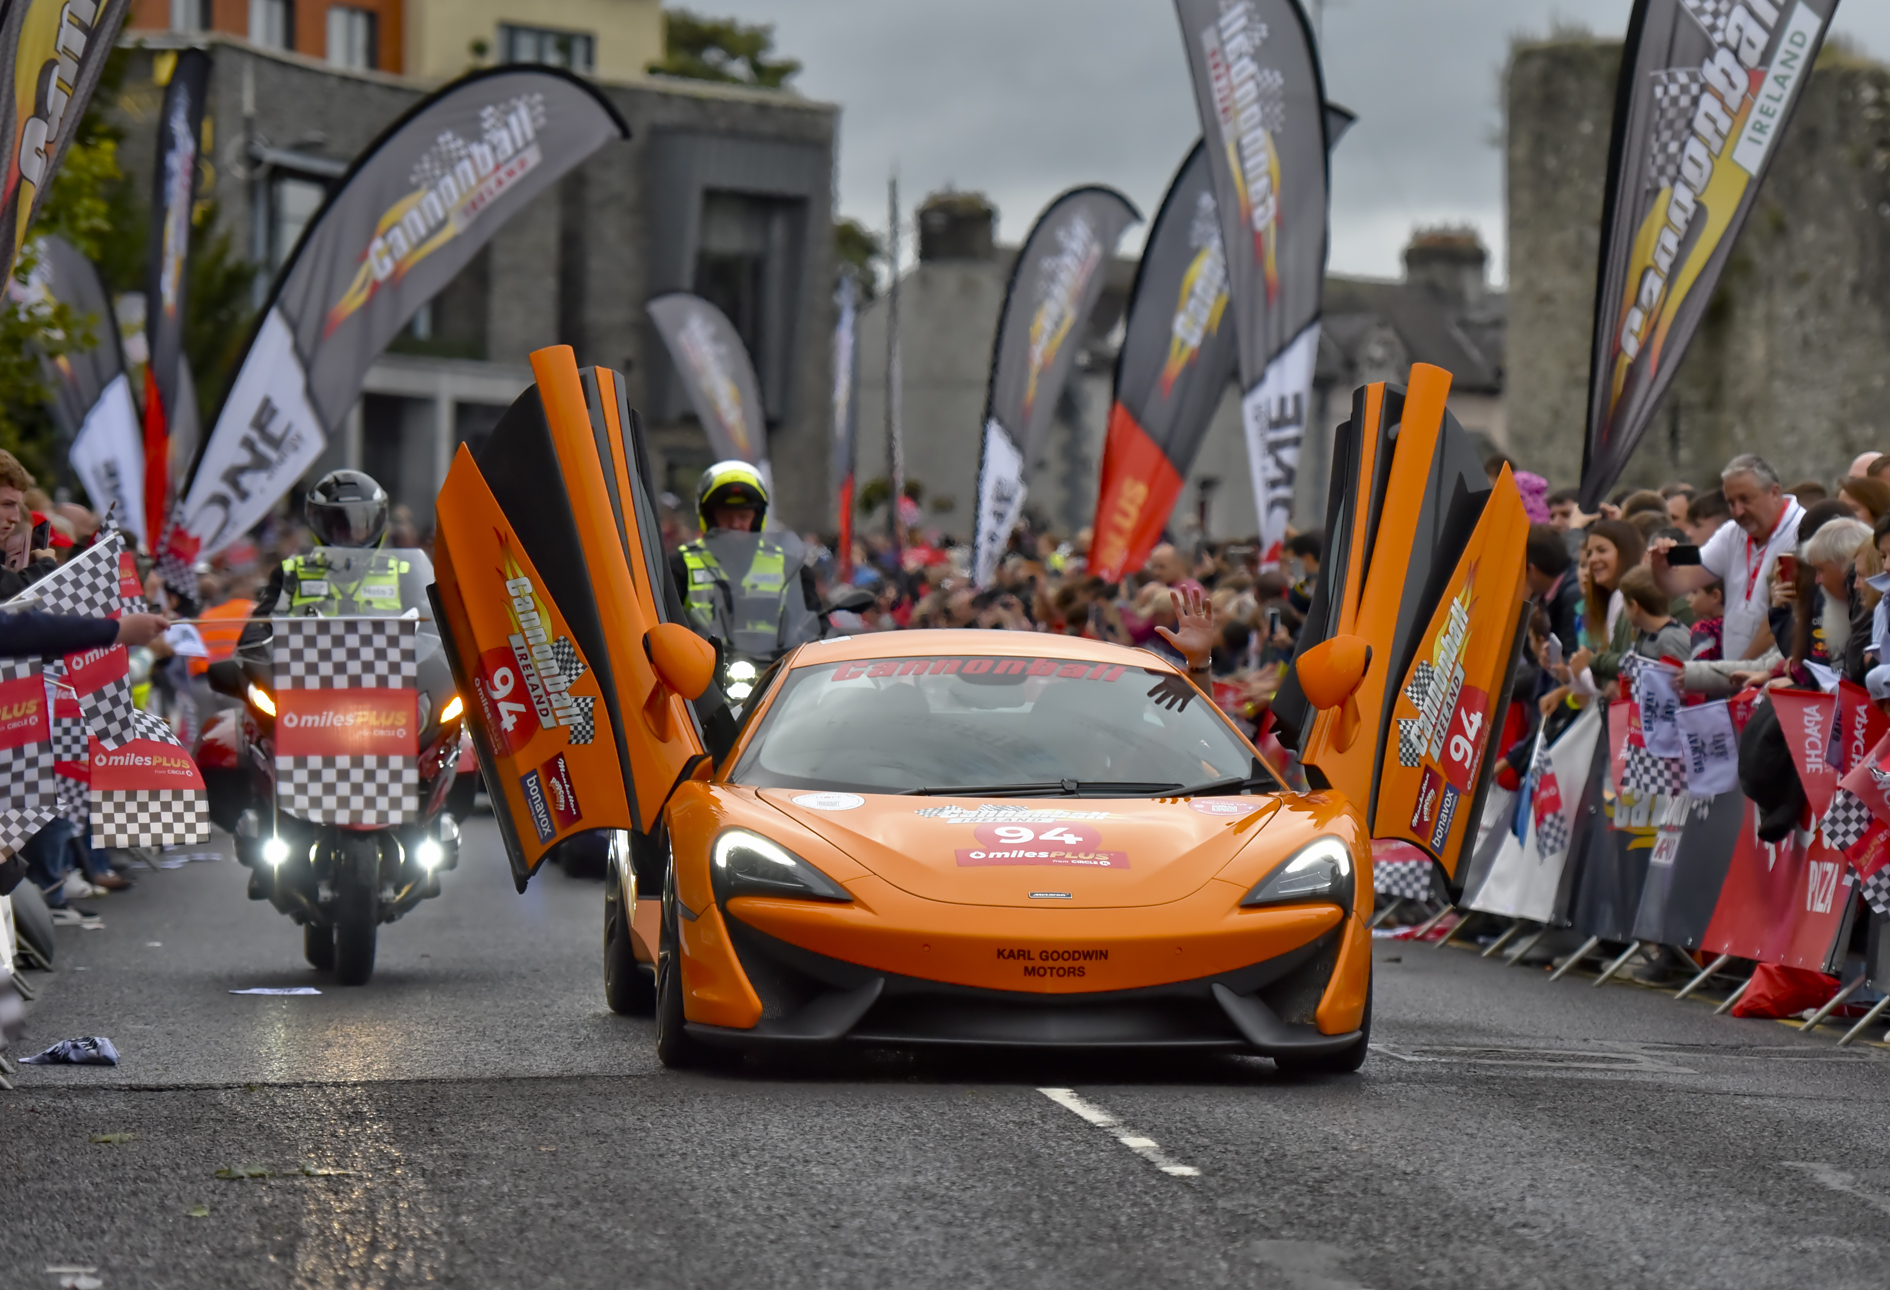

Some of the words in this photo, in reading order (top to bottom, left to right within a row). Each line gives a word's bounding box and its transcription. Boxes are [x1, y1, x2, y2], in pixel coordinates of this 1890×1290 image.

[1746, 29, 1808, 147] IRELAND
[368, 100, 536, 283] Cannonball
[506, 576, 585, 727] Cannonball
[831, 658, 1127, 682] Cannonball
[1410, 597, 1469, 757] Cannonball
[485, 666, 527, 733] 94
[514, 645, 550, 719] IRELAND
[300, 711, 407, 727] milesPLUS
[1434, 674, 1461, 750] IRELAND
[1450, 707, 1483, 770] 94
[108, 753, 190, 769] milesPLUS
[557, 757, 577, 816] Manhattan
[526, 774, 552, 837] bonavox
[550, 776, 565, 811] popcorn
[939, 809, 1110, 820] Cannonball
[1411, 772, 1430, 828] Manhattan
[1423, 788, 1436, 822] popcorn
[1431, 789, 1454, 848] bonavox
[988, 850, 1109, 861] milesPLUS
[994, 826, 1083, 844] 94
[997, 948, 1035, 960] KARL
[1039, 949, 1109, 962] GOODWIN
[1023, 966, 1086, 978] MOTORS
